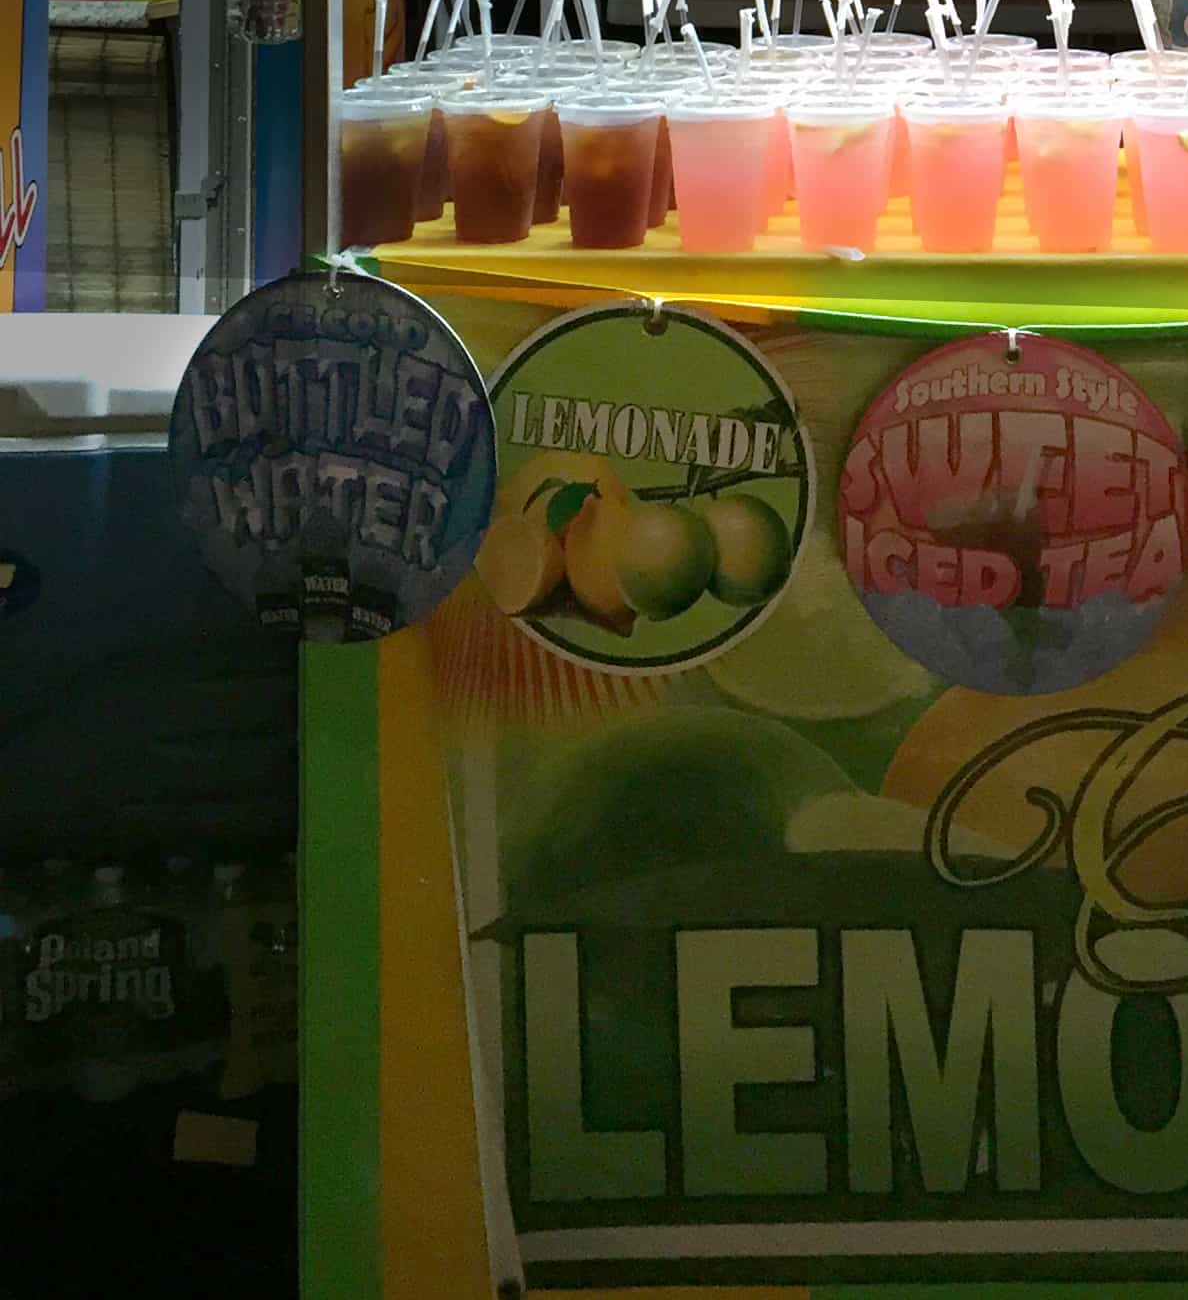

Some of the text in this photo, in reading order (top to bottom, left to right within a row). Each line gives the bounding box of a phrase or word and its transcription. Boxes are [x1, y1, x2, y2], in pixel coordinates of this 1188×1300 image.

[319, 306, 431, 352] COLD
[190, 338, 486, 477] BOTTLED
[509, 391, 782, 474] LEMONADE
[894, 364, 1140, 417] Southern Style
[212, 450, 450, 571] WATER
[841, 410, 1178, 536] SWEET
[845, 514, 1184, 610] ICED TEA
[24, 964, 178, 1023] Spring
